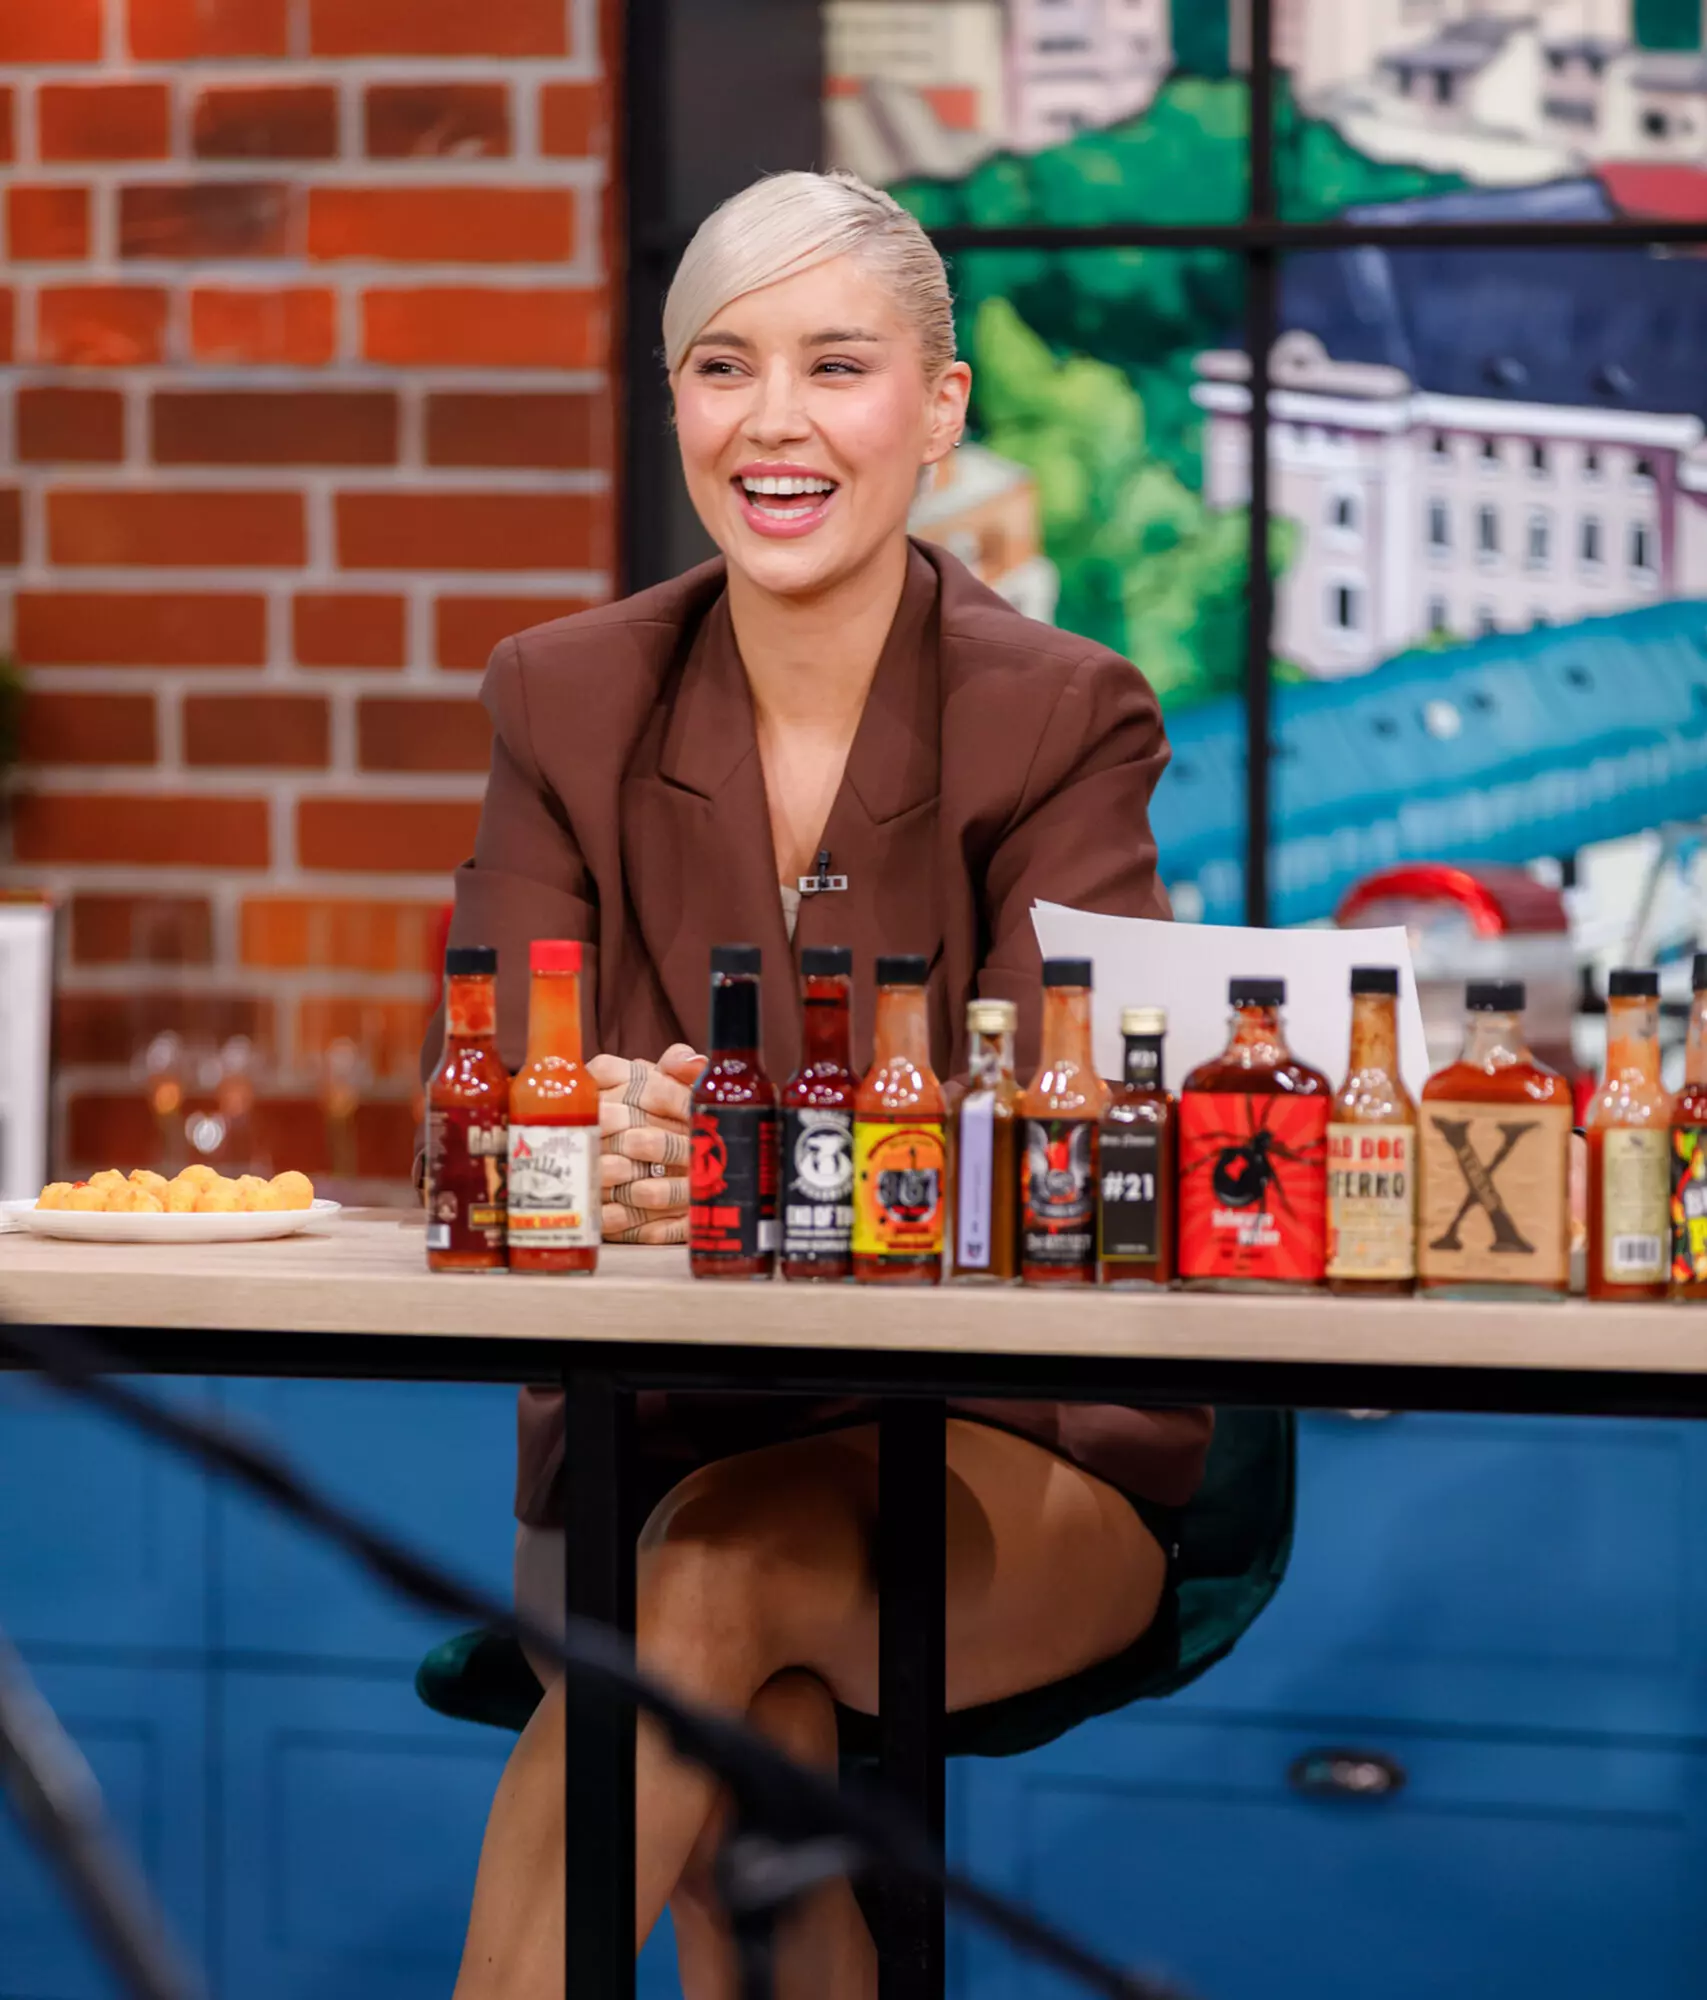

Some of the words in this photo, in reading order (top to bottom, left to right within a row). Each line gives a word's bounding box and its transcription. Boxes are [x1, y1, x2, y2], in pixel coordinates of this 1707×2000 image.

[1360, 1137, 1405, 1160] DOG
[1102, 1170, 1155, 1202] #21
[1429, 1115, 1543, 1254] X
